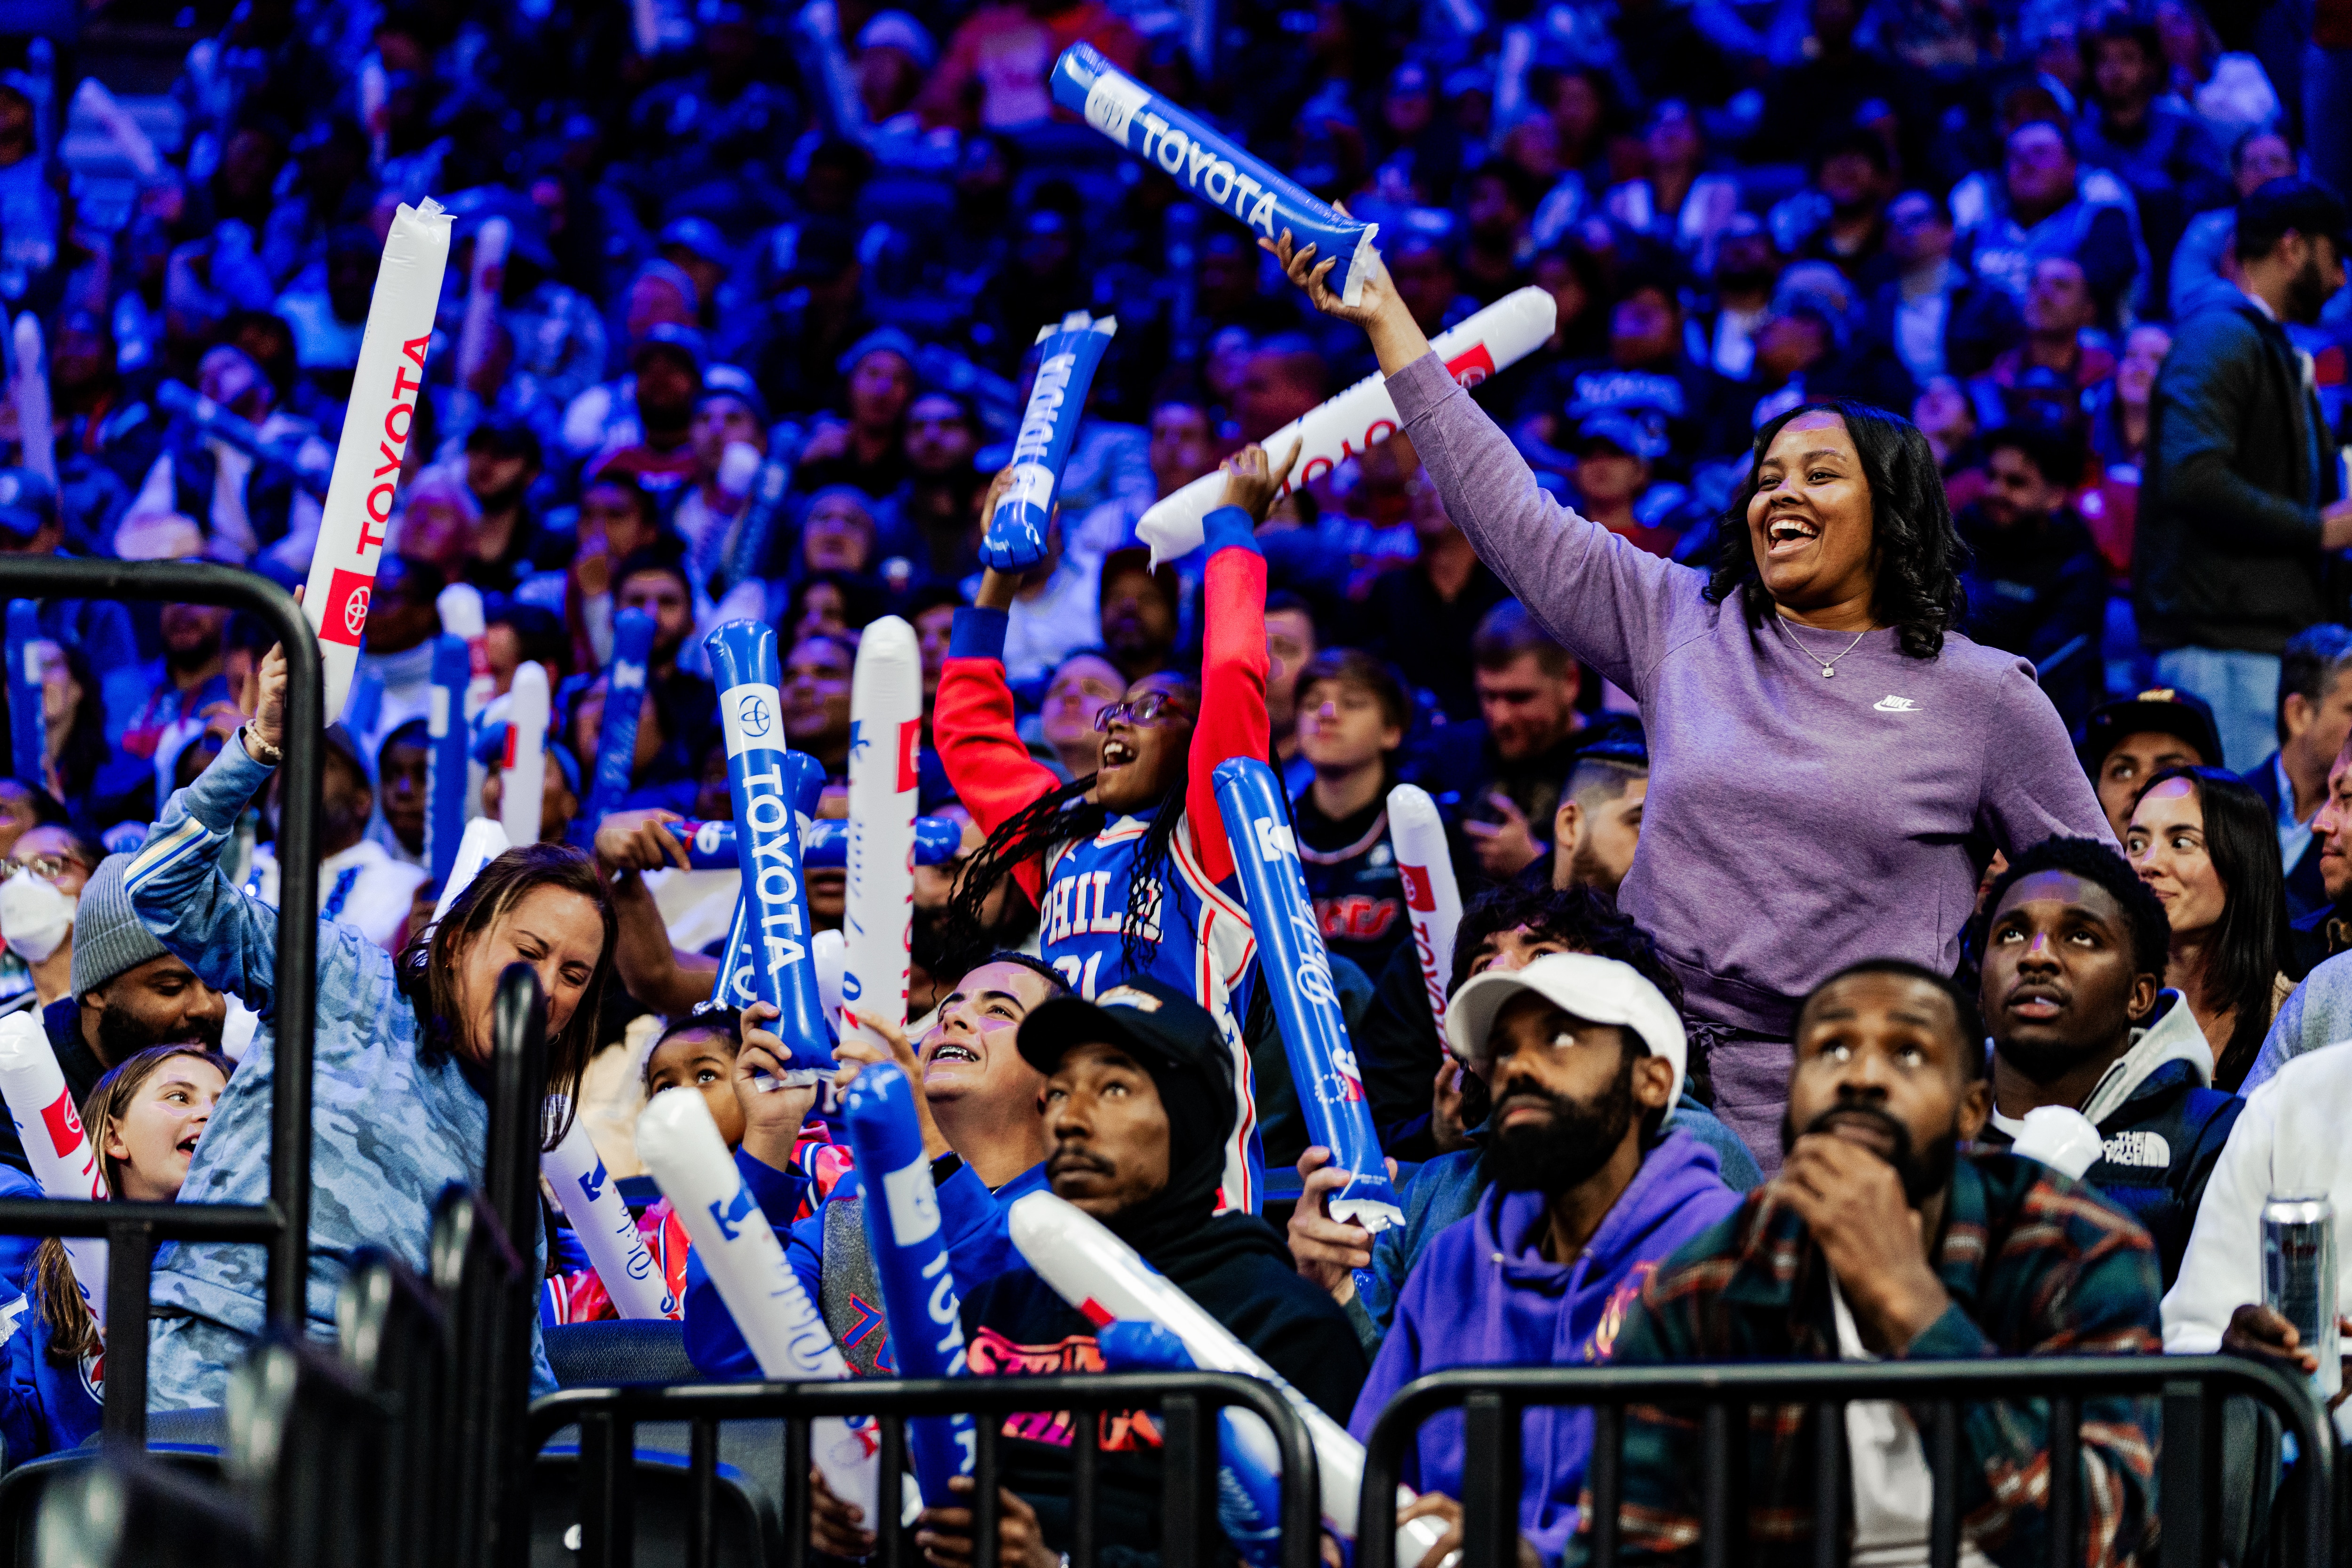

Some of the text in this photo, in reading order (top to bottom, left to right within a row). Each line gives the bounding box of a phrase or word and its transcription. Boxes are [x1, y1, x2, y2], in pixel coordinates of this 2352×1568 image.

[1143, 111, 1278, 239] TOYOTA
[356, 333, 431, 556] TOYOTA
[1881, 695, 1915, 709] NIKE
[741, 763, 806, 976] TOYOTA
[1039, 870, 1164, 947] PHILA
[2101, 1139, 2145, 1154] ORTH
[2106, 1151, 2143, 1166] FACE
[2116, 1131, 2145, 1144] THE
